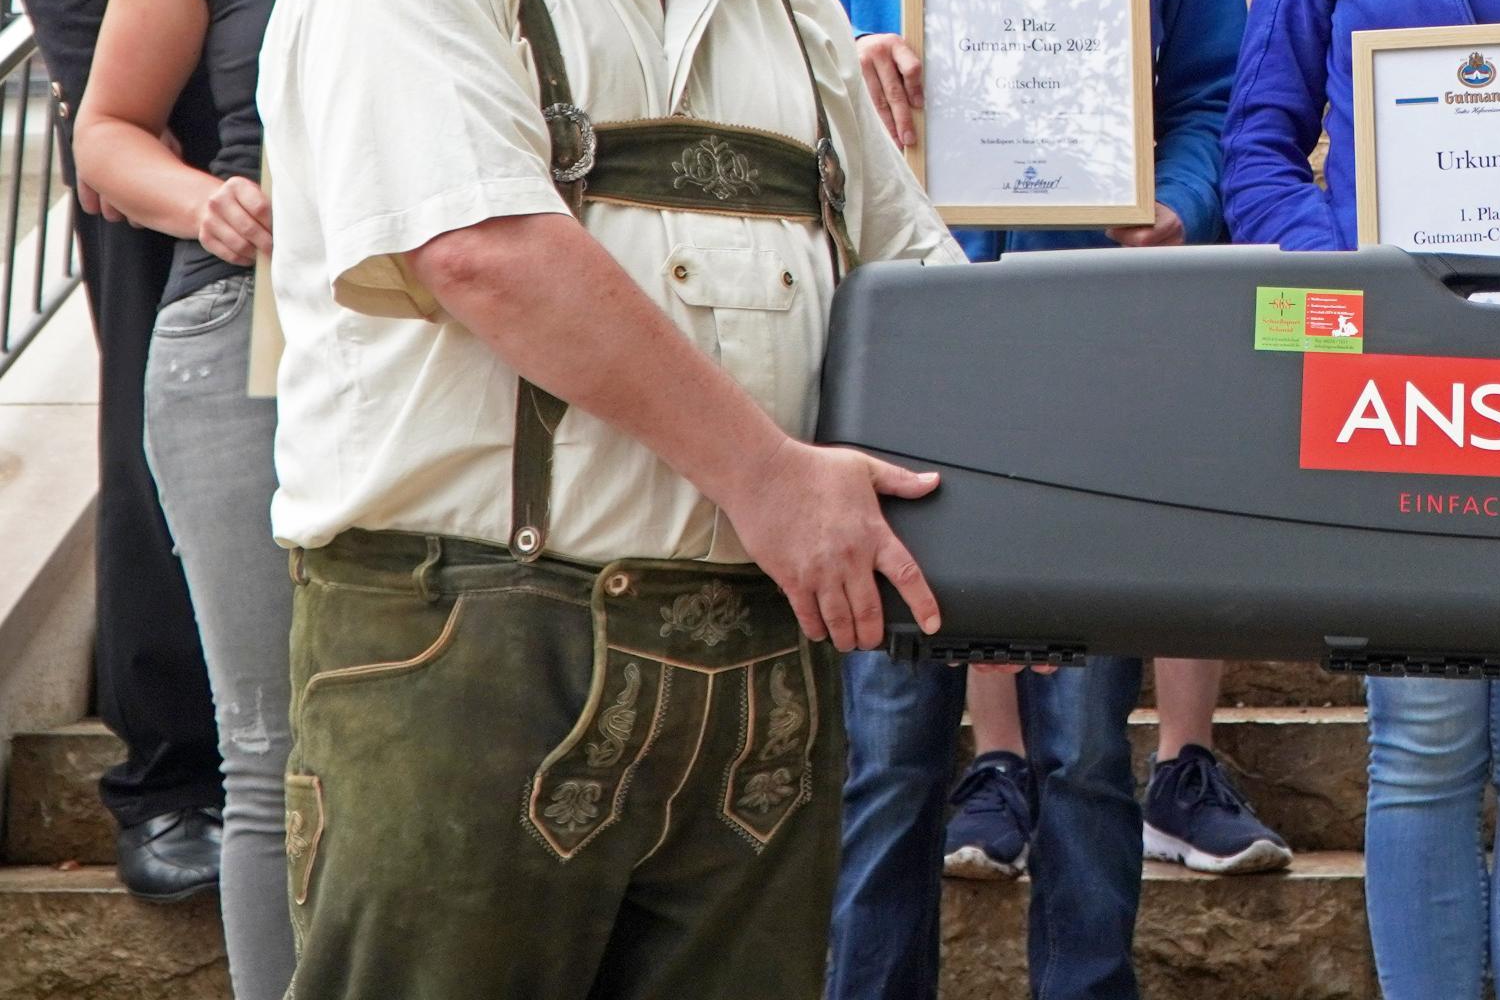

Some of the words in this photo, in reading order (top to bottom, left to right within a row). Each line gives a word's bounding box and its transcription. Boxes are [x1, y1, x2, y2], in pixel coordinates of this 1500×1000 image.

[1003, 18, 1016, 33] 2.
[1021, 18, 1057, 33] Platz
[995, 76, 1061, 89] Gutschein
[1459, 208, 1472, 222] 1.
